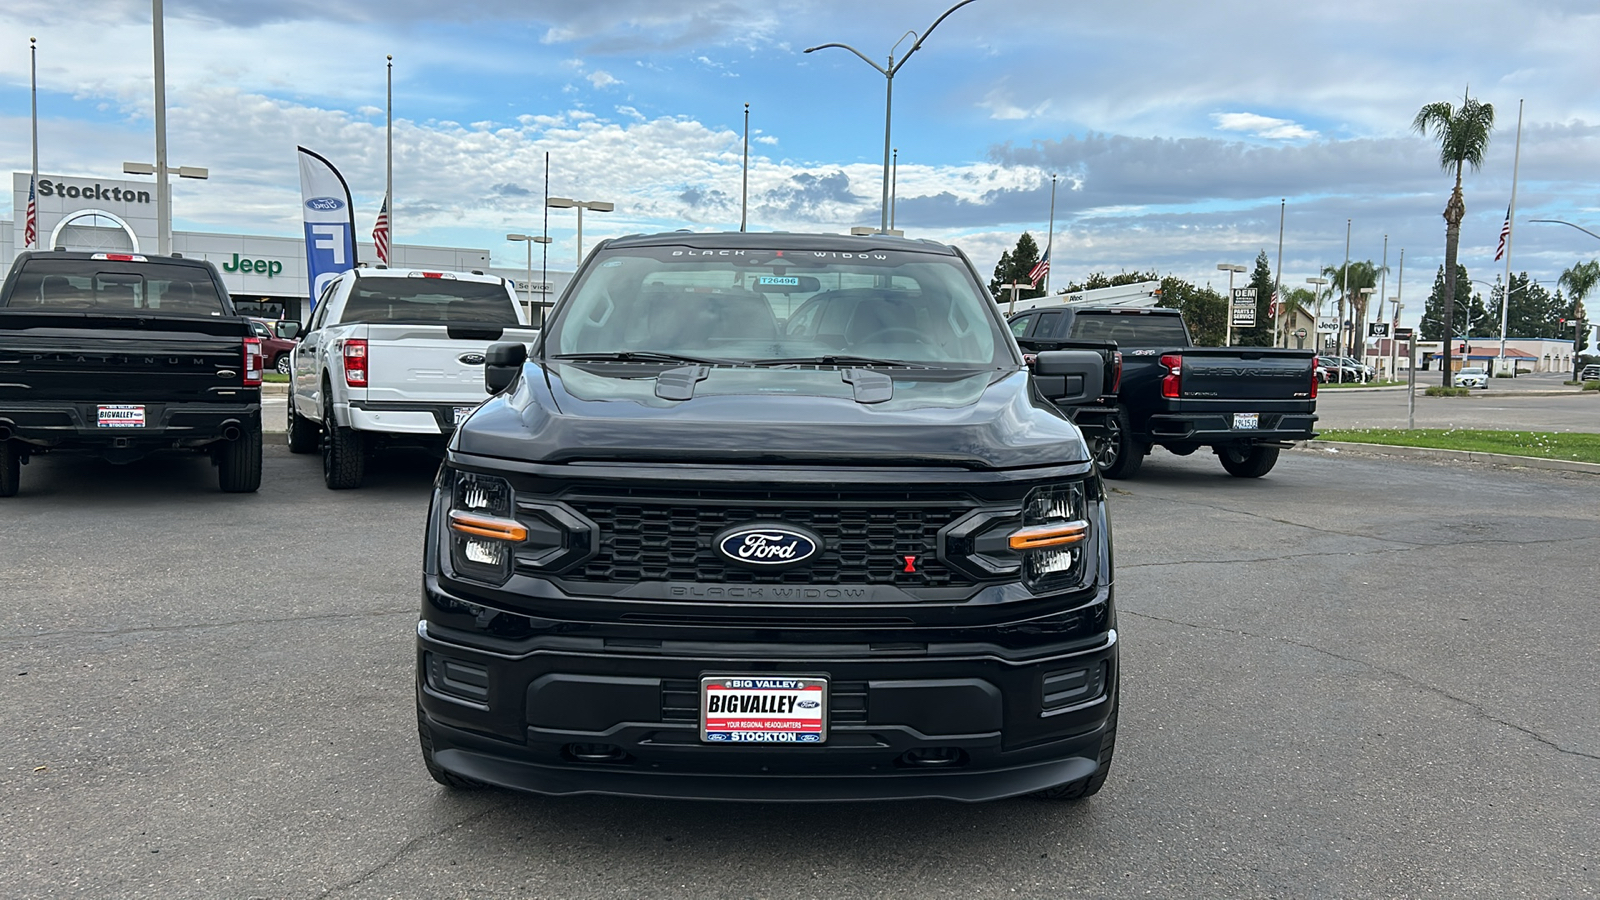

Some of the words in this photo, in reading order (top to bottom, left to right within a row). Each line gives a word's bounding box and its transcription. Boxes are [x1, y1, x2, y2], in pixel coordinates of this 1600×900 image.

[37, 179, 151, 204] Stockton
[813, 251, 888, 261] WIDOW
[222, 252, 283, 279] Jeep
[761, 276, 796, 285] T26496
[1068, 294, 1083, 302] Altec
[1318, 321, 1339, 331] Jeep
[32, 353, 205, 366] PLATINUM
[738, 533, 796, 560] Ford
[669, 586, 763, 598] BLACK
[772, 588, 866, 599] WIDOW
[733, 680, 753, 688] BIG
[755, 680, 797, 688] VALLEY
[708, 694, 798, 714] BIGVALLEY
[740, 721, 763, 729] REGIONAL
[764, 721, 802, 729] HEADQUARTERS
[731, 732, 796, 742] STOCKTON
